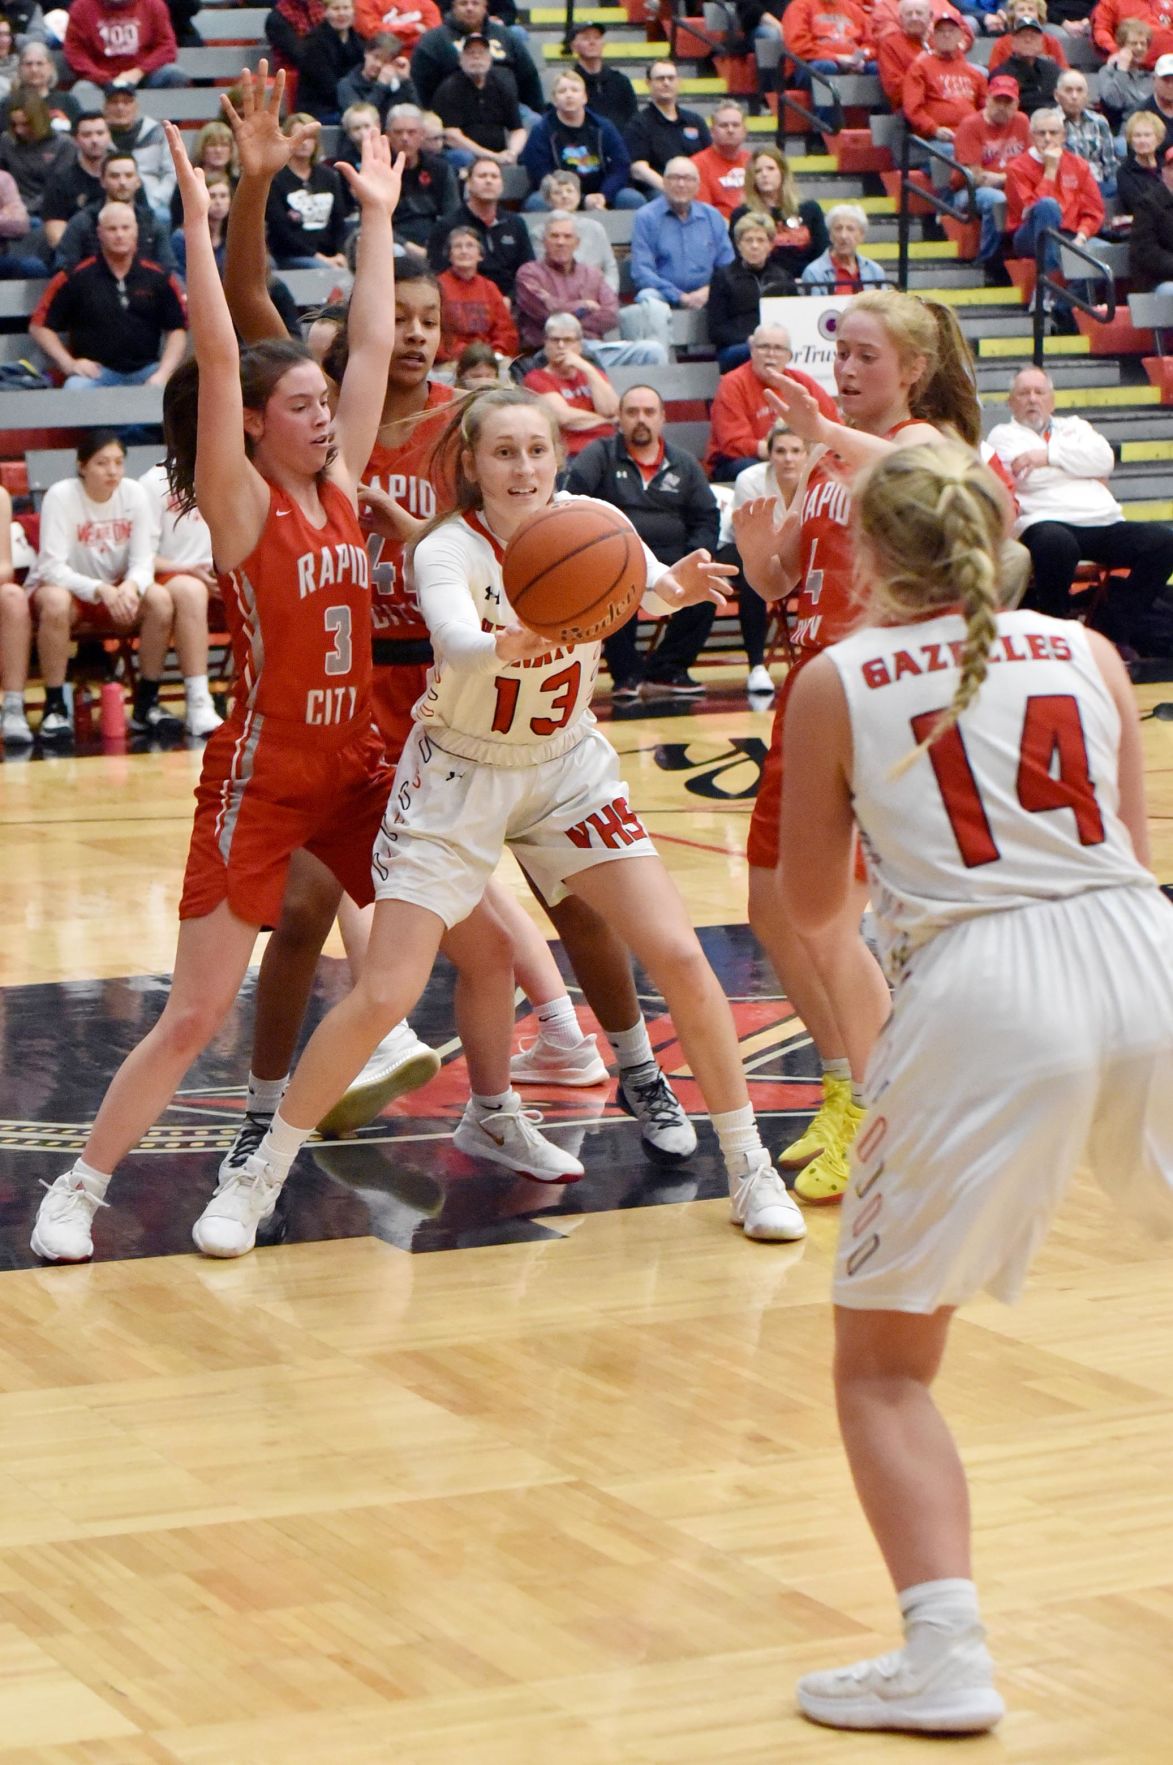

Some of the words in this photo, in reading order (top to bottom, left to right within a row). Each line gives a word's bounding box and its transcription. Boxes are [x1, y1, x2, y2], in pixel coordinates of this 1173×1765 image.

[297, 543, 369, 599] RAPID
[324, 605, 353, 676] 3
[491, 661, 582, 735] 13
[910, 694, 1106, 869] 14
